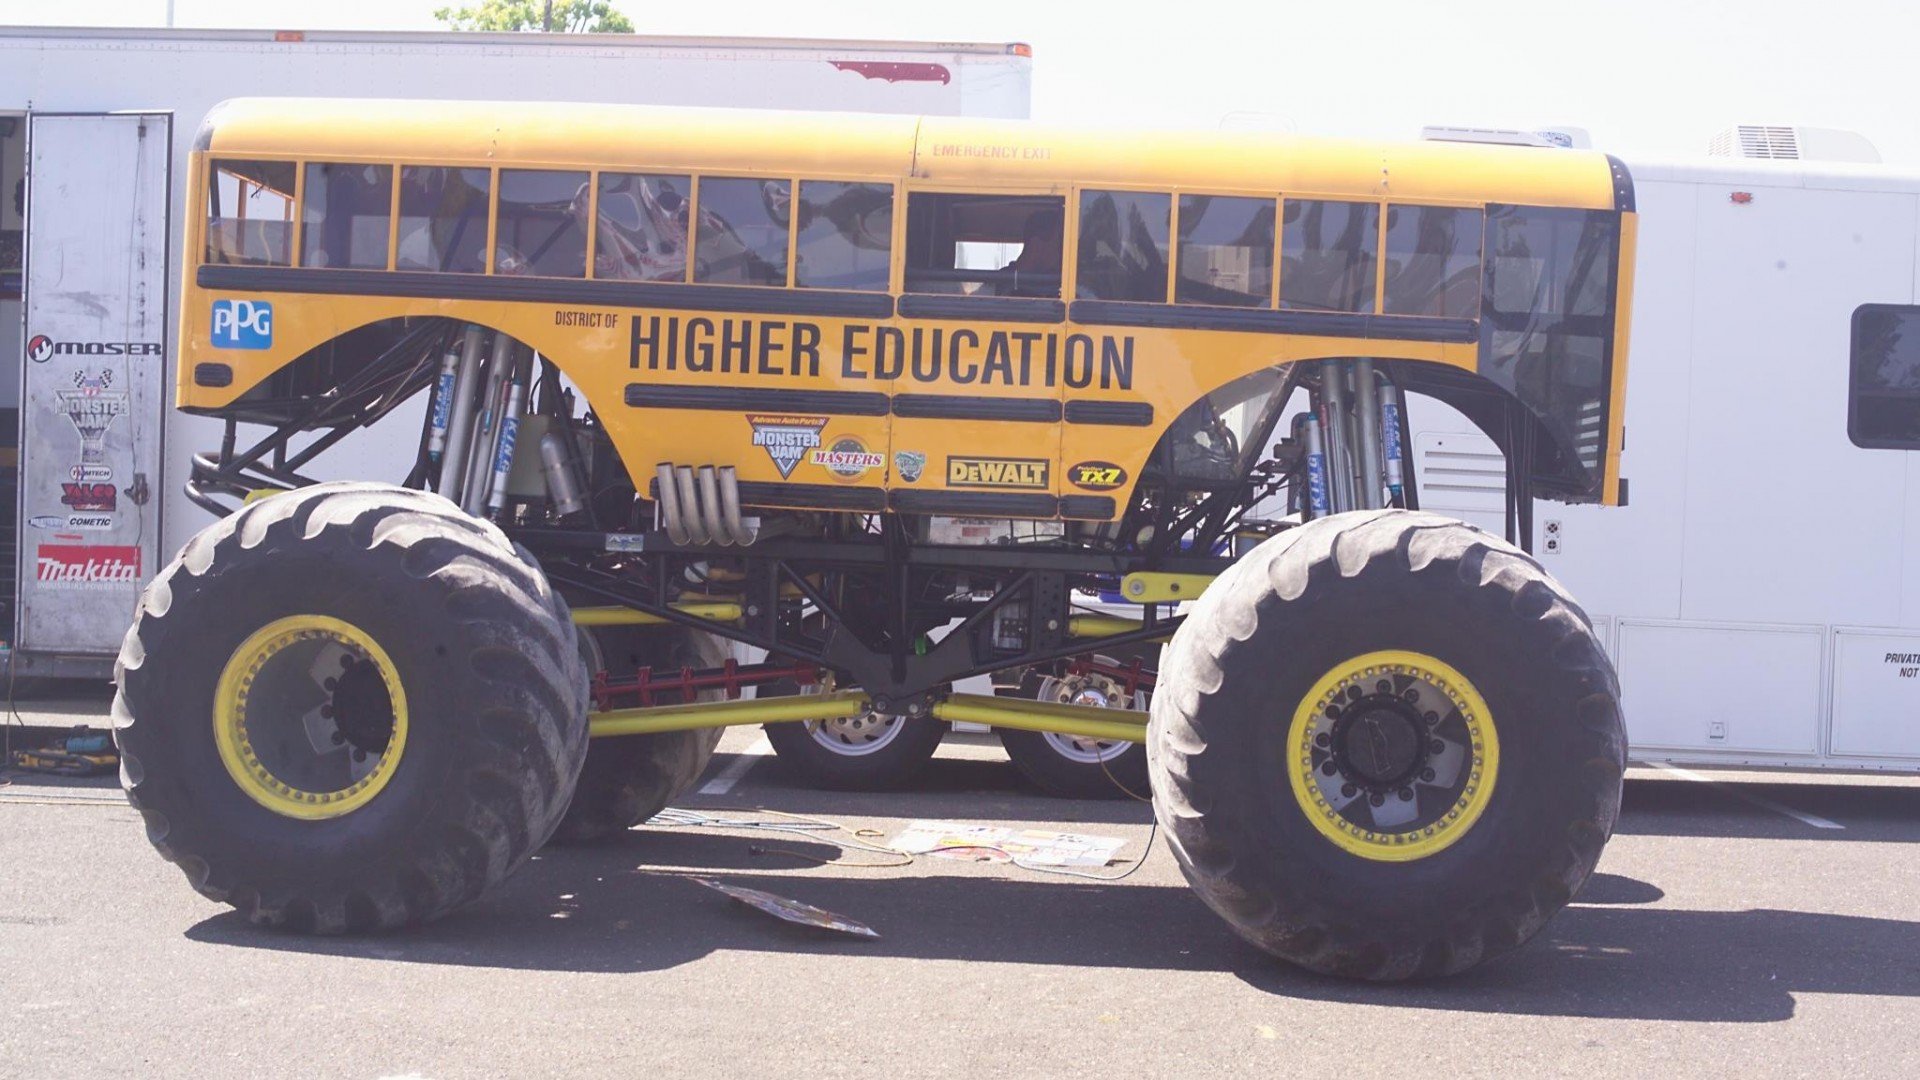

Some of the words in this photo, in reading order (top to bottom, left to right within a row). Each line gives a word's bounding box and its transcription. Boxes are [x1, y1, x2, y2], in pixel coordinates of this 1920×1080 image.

[933, 144, 1018, 159] EMERGENCY
[1023, 147, 1055, 160] EXIT
[214, 300, 270, 341] PPG
[555, 311, 602, 328] DISTRICT
[605, 314, 619, 329] OF
[55, 342, 162, 355] MOSER
[629, 315, 821, 377] HIGHER
[841, 324, 1135, 390] EDUCATION
[55, 398, 129, 416] MONSTER
[753, 432, 821, 447] MONSTER
[769, 445, 803, 460] JAM
[813, 451, 883, 467] MASTERS
[69, 517, 111, 526] COMETIC
[1899, 667, 1919, 678] NOT
